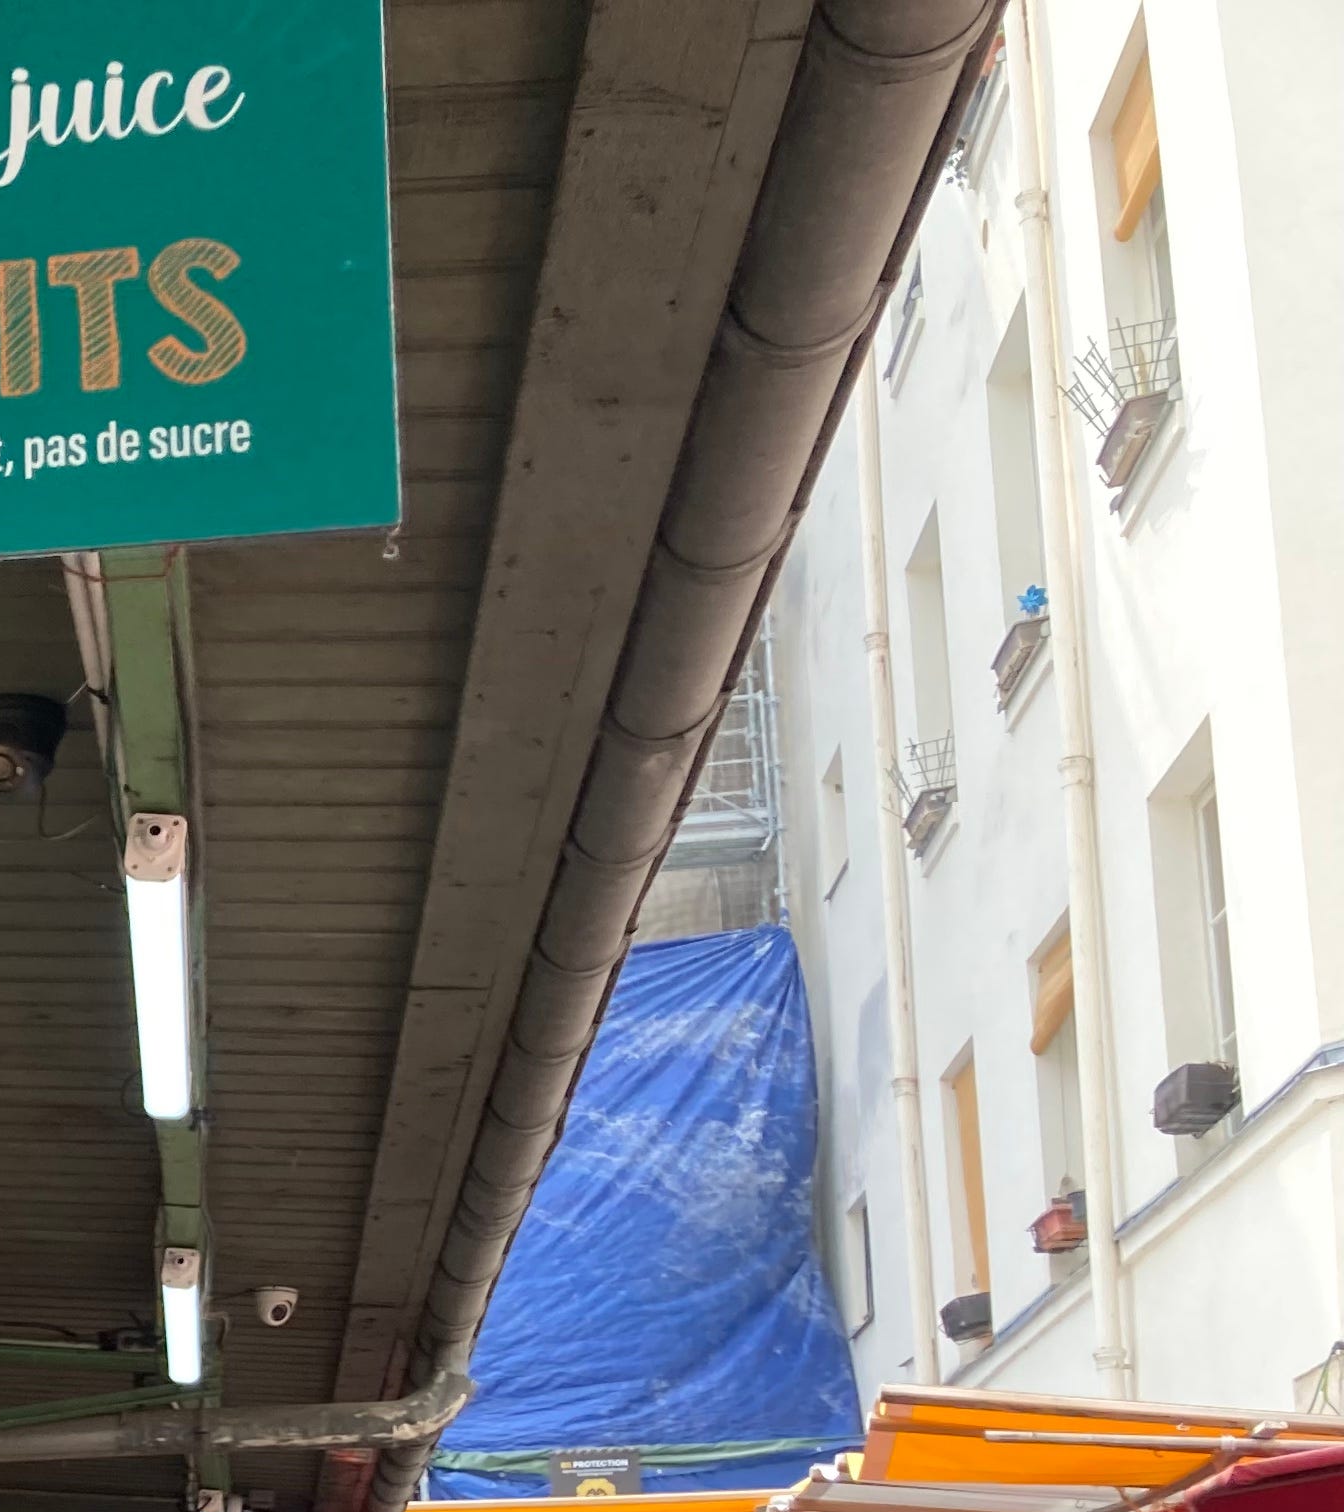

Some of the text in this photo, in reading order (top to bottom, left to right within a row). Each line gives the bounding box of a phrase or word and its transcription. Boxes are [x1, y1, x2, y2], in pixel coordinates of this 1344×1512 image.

[24, 432, 87, 480] pas
[96, 420, 140, 463] de
[149, 419, 251, 460] sucre
[573, 1459, 629, 1469] PROTECTION
